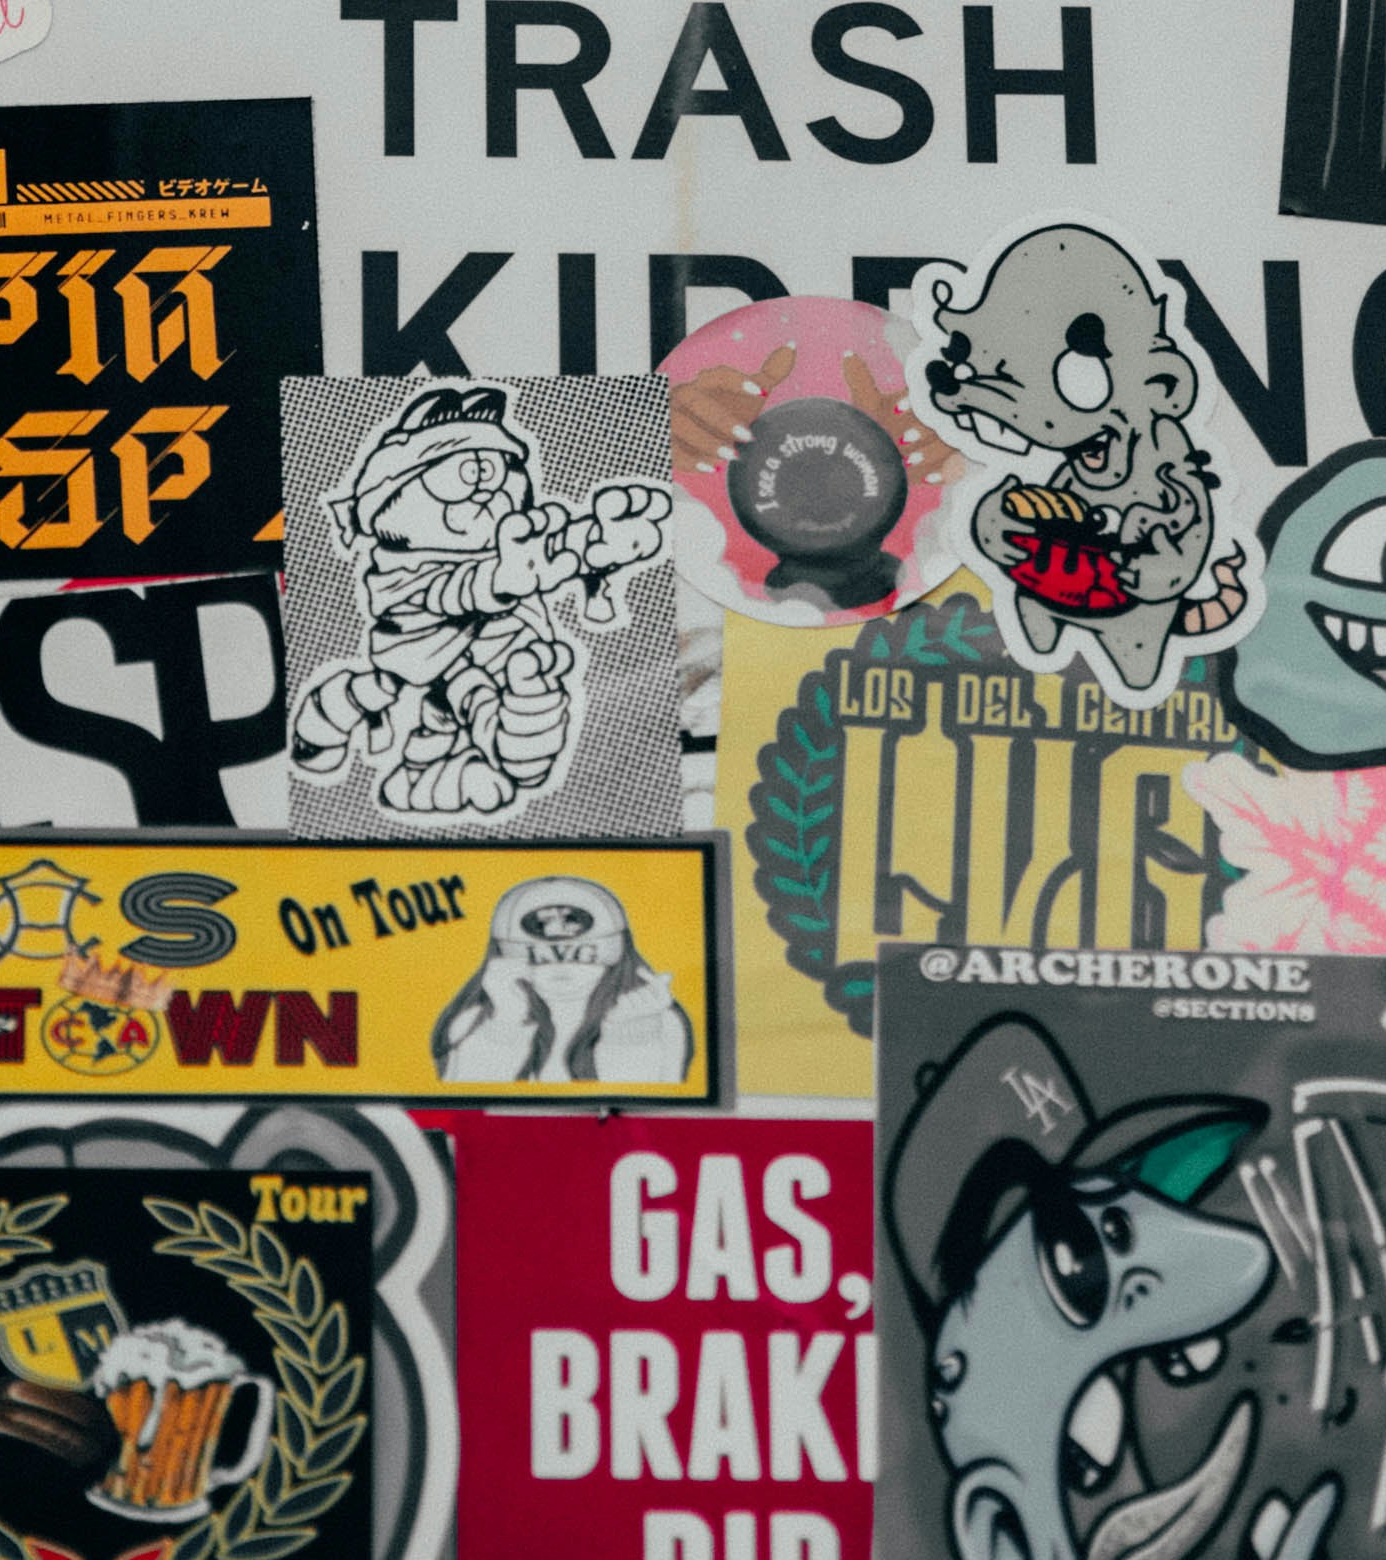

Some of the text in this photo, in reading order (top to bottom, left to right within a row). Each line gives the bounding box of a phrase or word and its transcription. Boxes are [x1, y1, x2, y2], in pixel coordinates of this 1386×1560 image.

[158, 178, 269, 198] ビデオゲーム
[44, 207, 230, 225] METAL_FINGERS_KREW
[778, 432, 839, 458] strong
[842, 442, 880, 499] woman
[838, 659, 914, 720] LOS
[956, 673, 1033, 729] DEL
[278, 896, 351, 955] On
[351, 872, 468, 941] Tour
[525, 943, 598, 966] LVG
[919, 947, 1313, 993] @ARCHERONE
[249, 1175, 369, 1225] Tour
[609, 1150, 873, 1321] GAS,
